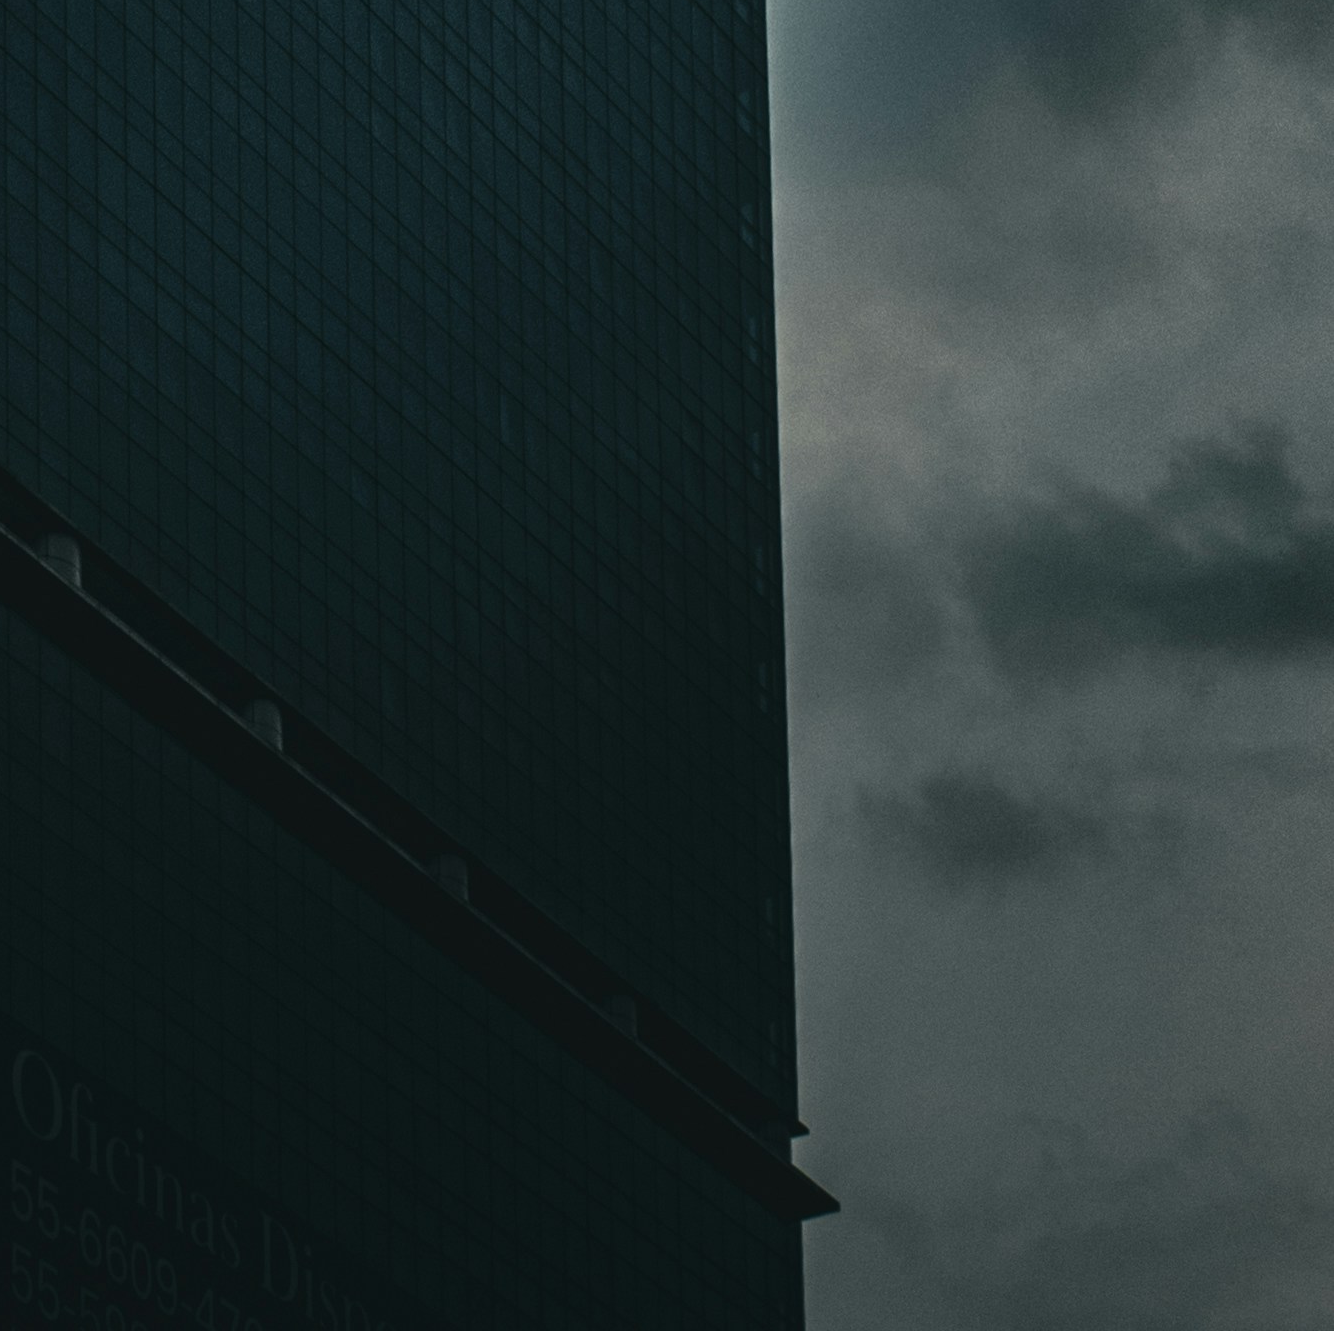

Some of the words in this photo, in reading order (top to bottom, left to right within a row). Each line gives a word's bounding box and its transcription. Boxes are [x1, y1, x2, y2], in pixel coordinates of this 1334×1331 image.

[11, 1157, 264, 1331] 55-6609-47
[12, 1048, 241, 1269] Oficinas
[259, 1209, 397, 1331] Disp
